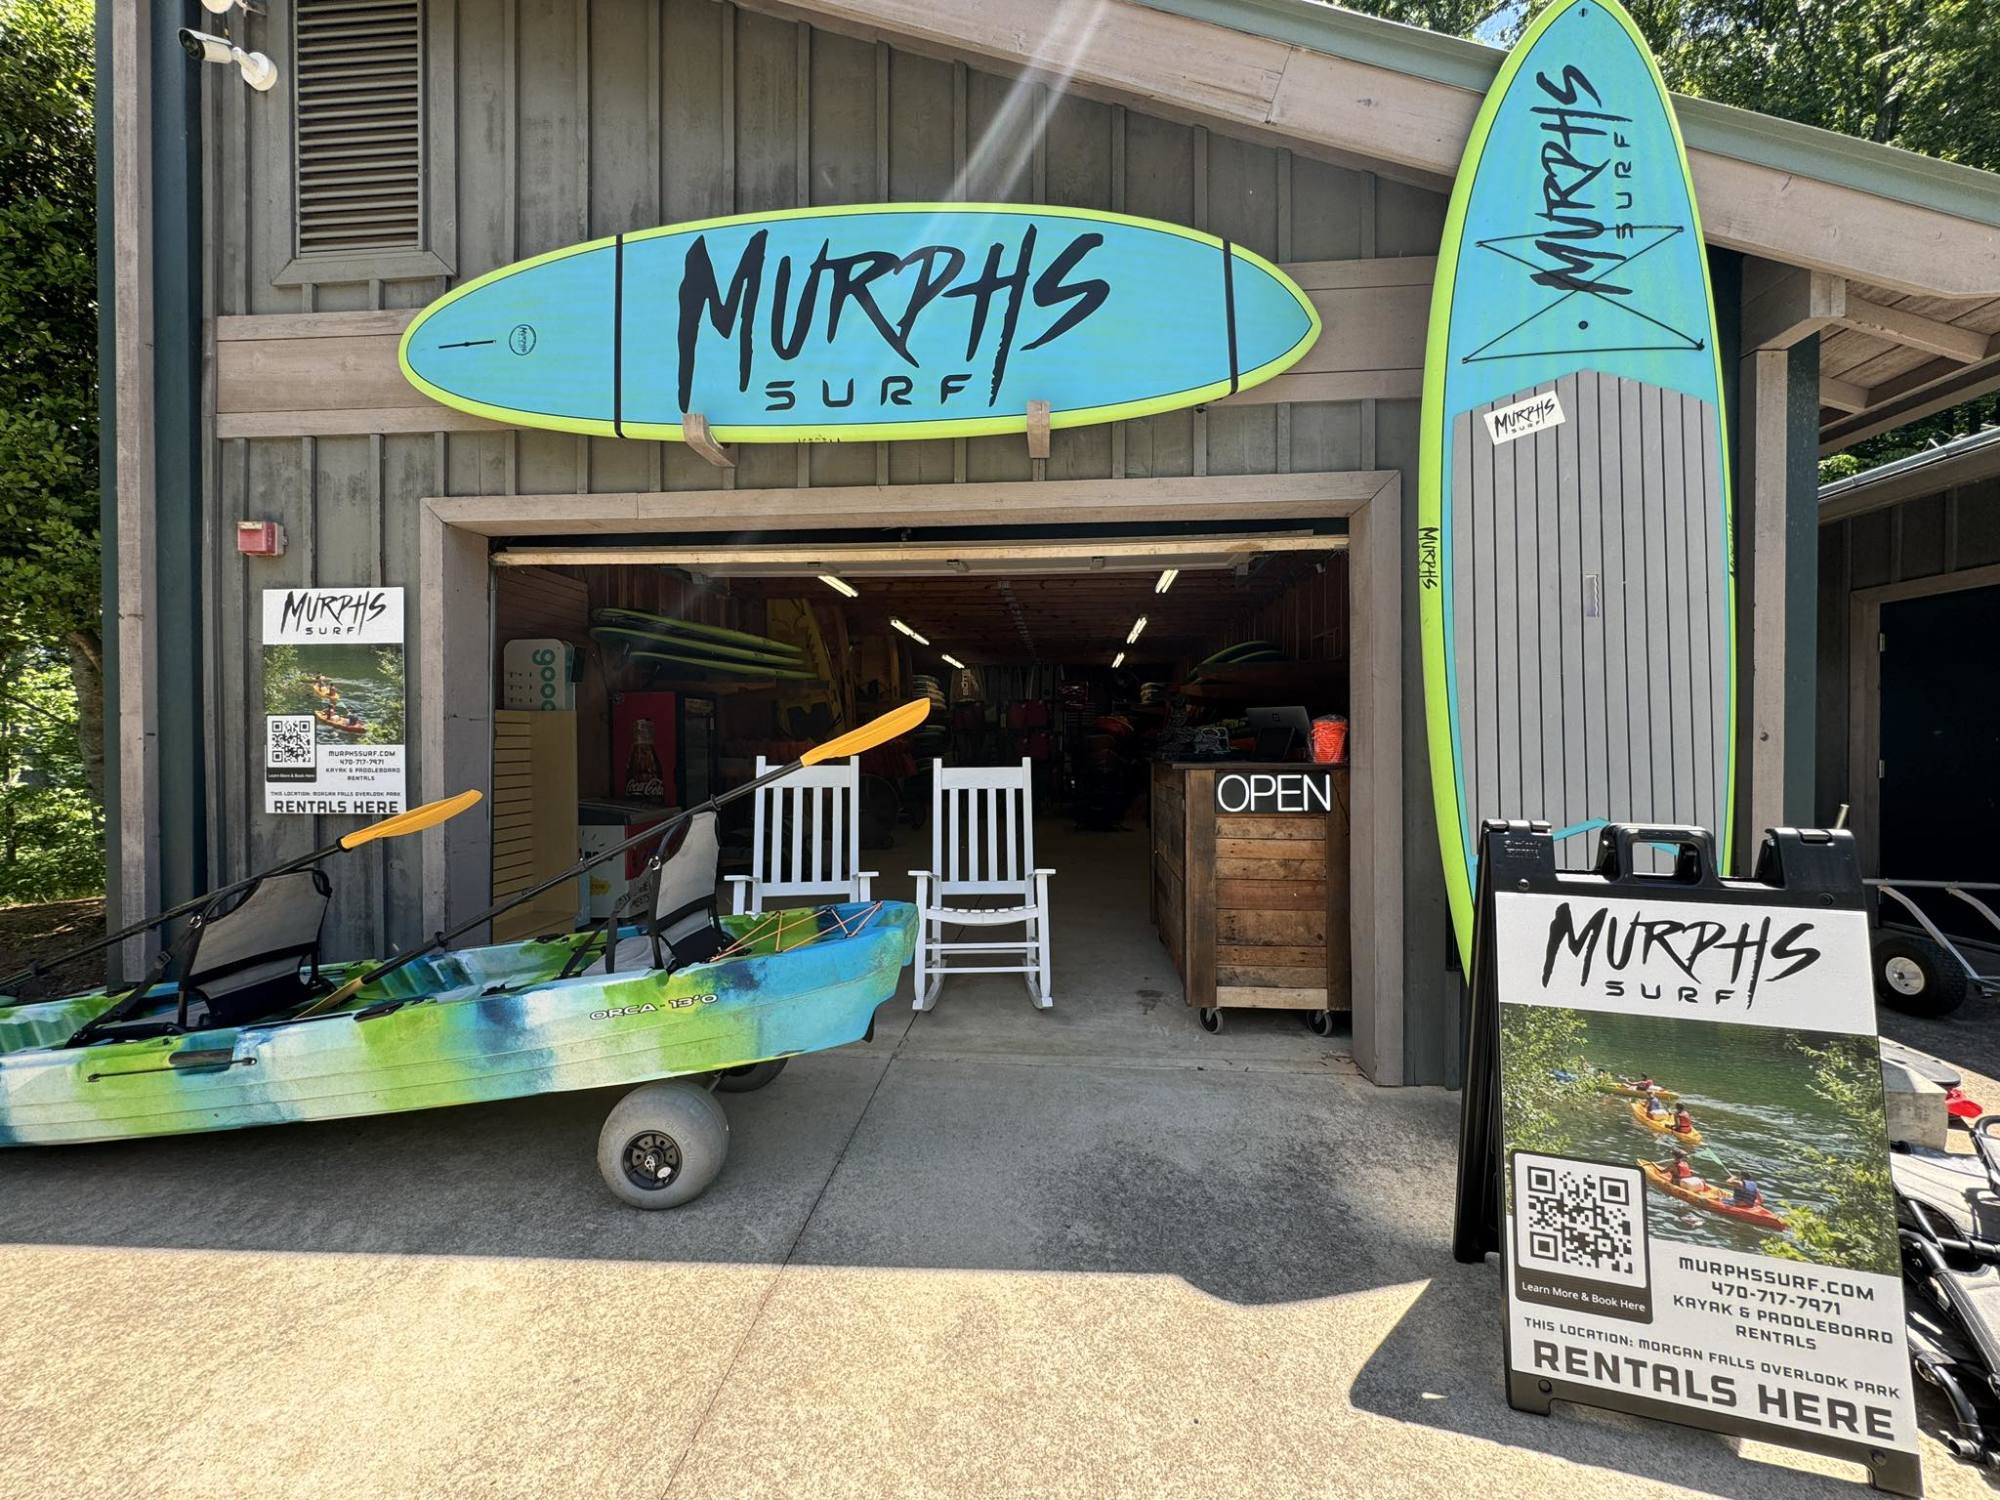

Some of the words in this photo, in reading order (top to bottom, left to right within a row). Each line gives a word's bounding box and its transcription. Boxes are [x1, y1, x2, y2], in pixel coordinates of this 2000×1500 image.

[1529, 65, 1633, 295] MURPHS
[1614, 133, 1633, 239] SURF
[678, 223, 1110, 412] MURPHS
[765, 374, 972, 410] SURF
[1494, 398, 1555, 438] MURPHS
[1418, 527, 1439, 590] MURPHS
[280, 590, 387, 636] MURPHS
[305, 626, 355, 636] SURF
[274, 800, 347, 813] RENTALS
[353, 800, 398, 813] HERE
[1217, 773, 1331, 812] OPEN
[1541, 902, 1821, 1010] MURPHS
[590, 1003, 658, 1020] ORCA
[1605, 980, 1737, 1004] SURF
[1521, 1281, 1550, 1295] Learn
[1552, 1287, 1578, 1300] More
[1580, 1292, 1590, 1302] &
[1592, 1293, 1618, 1307] Book
[1620, 1299, 1646, 1313] Here
[1679, 1256, 1874, 1301] MURPHSSURF.COM
[1711, 1281, 1841, 1315] 470-717-7971
[1673, 1294, 1733, 1316] KAYAK
[1739, 1306, 1750, 1318] &
[1757, 1309, 1893, 1344] PADDLEBOARD
[1735, 1325, 1817, 1350] RENTALS
[1524, 1317, 1555, 1331] THIS
[1560, 1323, 1633, 1347] LOCATION:
[1638, 1338, 1702, 1361] MORGAN
[1709, 1352, 1755, 1370] FALLS
[1761, 1362, 1848, 1389] OVERLOOK
[1854, 1380, 1901, 1399] PARK
[1533, 1339, 1737, 1408] RENTALS
[1757, 1383, 1895, 1442] HERE
